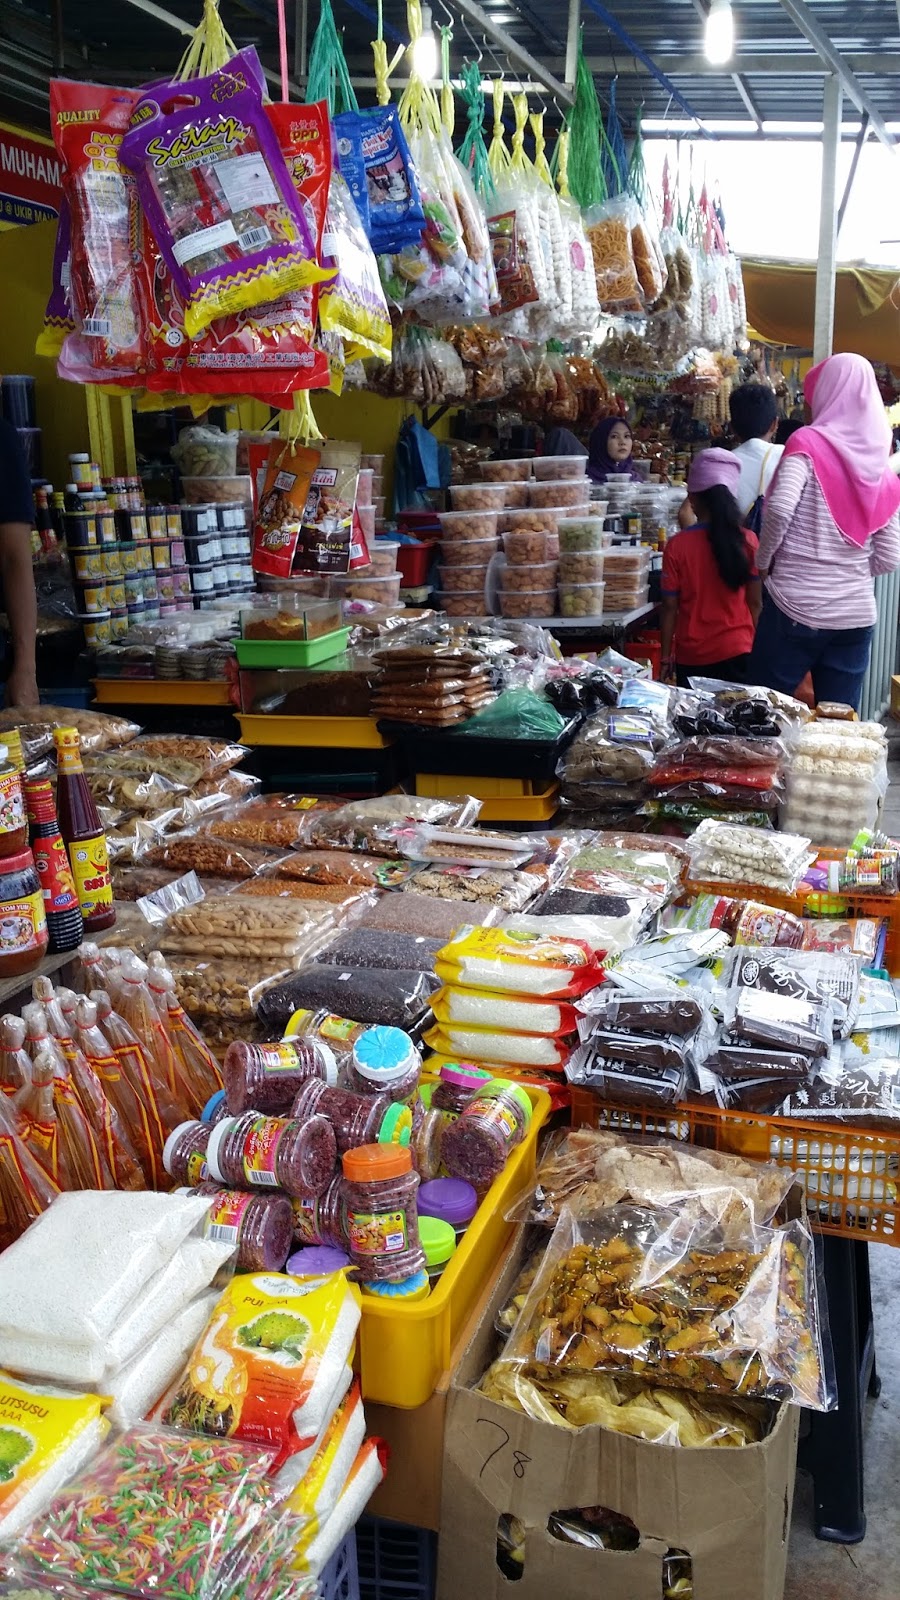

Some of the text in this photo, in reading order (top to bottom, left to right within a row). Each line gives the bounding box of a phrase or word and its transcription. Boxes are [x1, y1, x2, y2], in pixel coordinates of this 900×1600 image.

[57, 109, 101, 125] QUALITY
[91, 132, 124, 145] MA
[146, 117, 247, 166] Satay
[291, 129, 319, 143] PPT
[0, 143, 67, 188] MUHAM
[14, 204, 33, 220] UKIR
[83, 876, 105, 892] SOS
